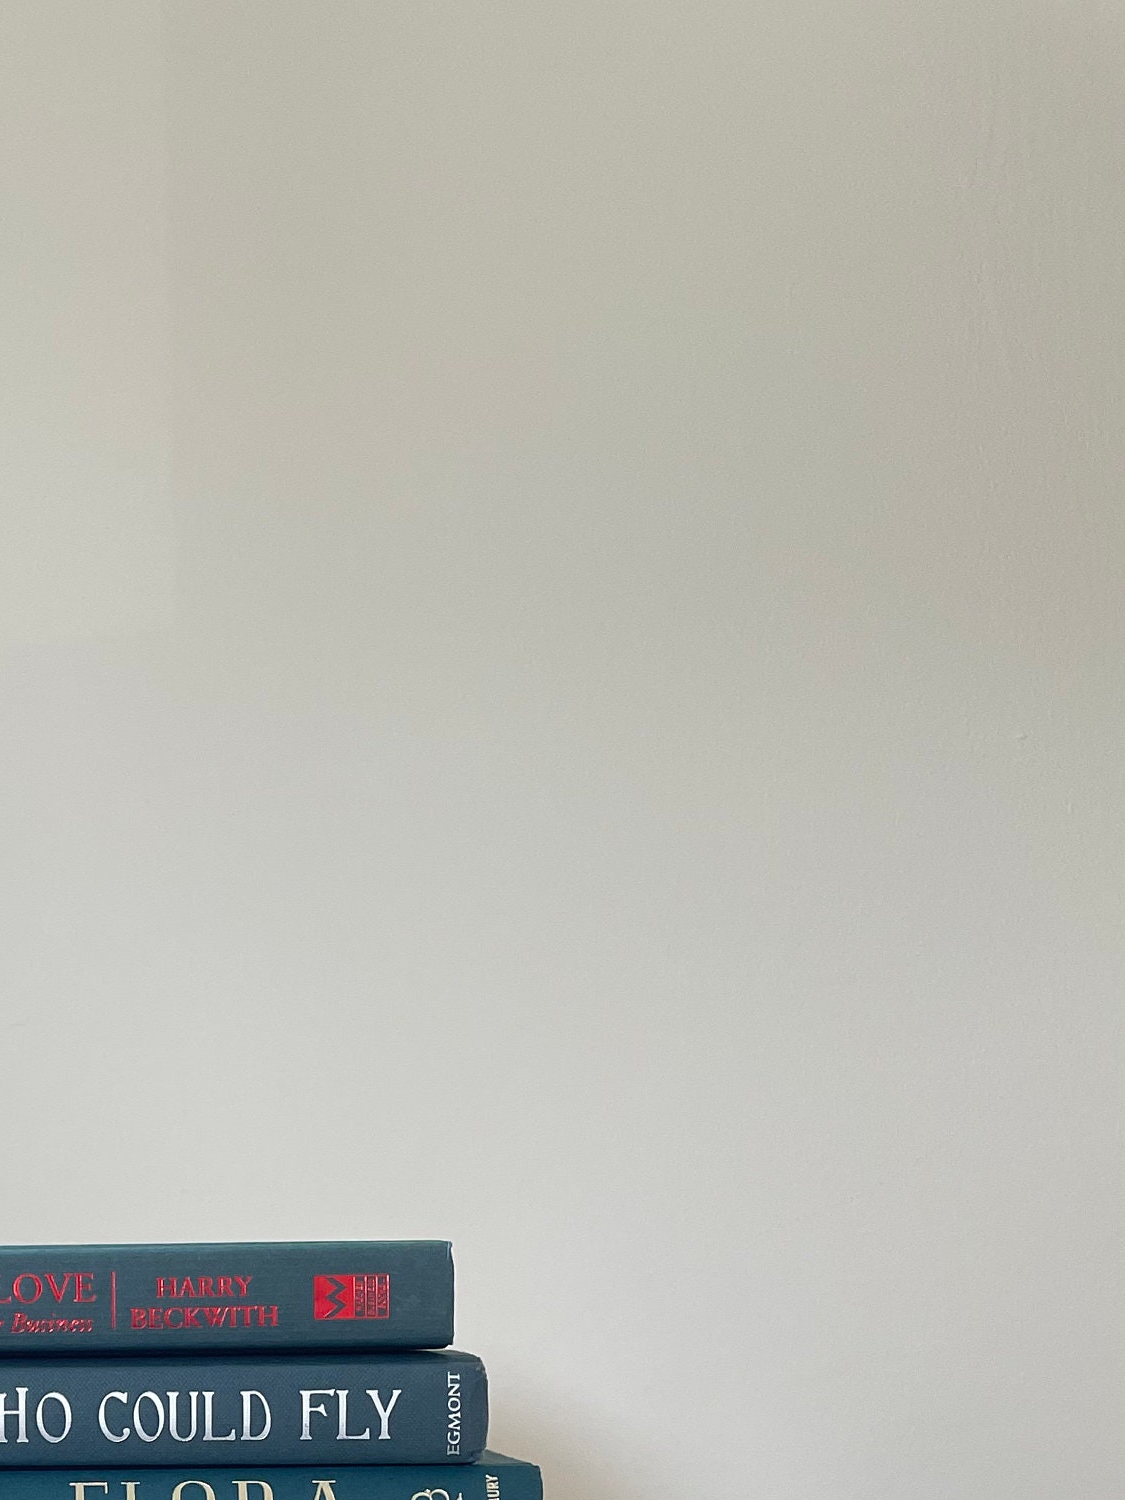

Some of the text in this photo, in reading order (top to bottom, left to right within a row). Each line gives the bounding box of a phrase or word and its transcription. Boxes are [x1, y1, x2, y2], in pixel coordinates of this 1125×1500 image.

[155, 1274, 253, 1300] HARRY
[130, 1304, 279, 1330] BECKWITH
[98, 1390, 272, 1443] COULD
[299, 1388, 402, 1441] FLY
[446, 1371, 461, 1455] EGMONT
